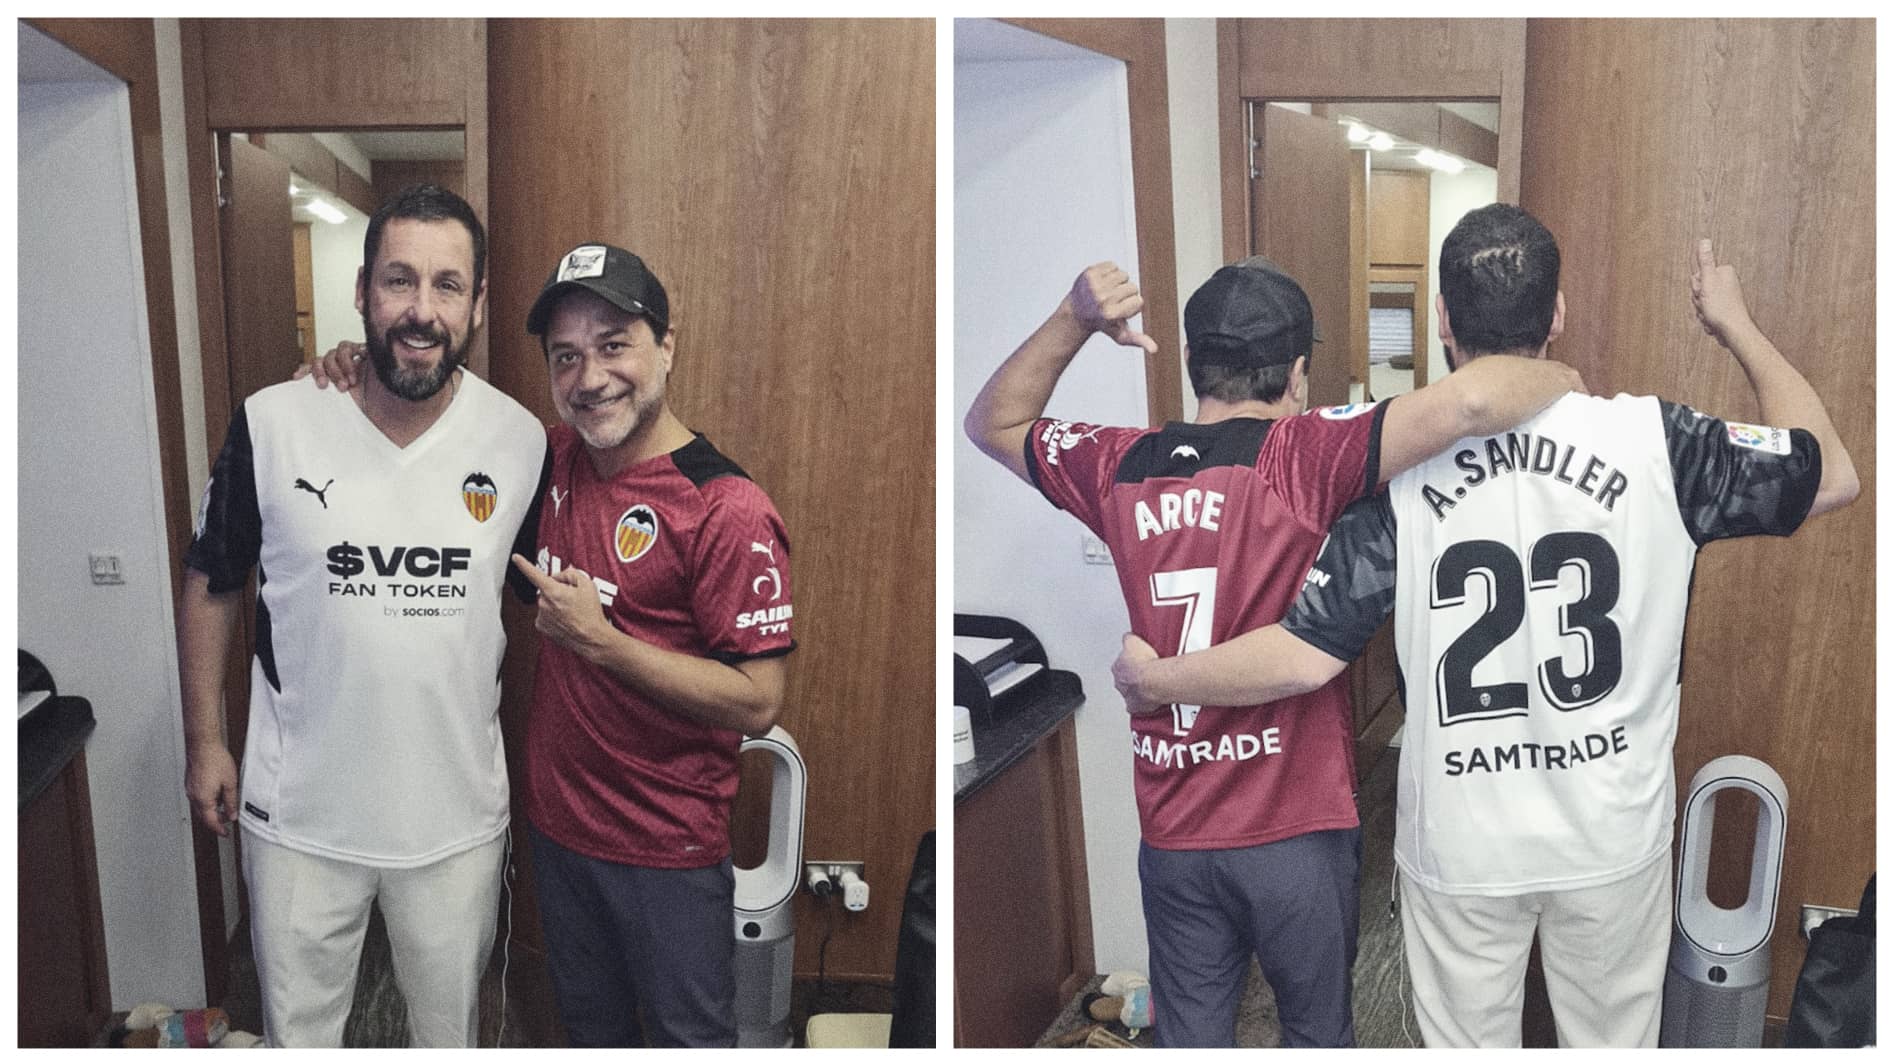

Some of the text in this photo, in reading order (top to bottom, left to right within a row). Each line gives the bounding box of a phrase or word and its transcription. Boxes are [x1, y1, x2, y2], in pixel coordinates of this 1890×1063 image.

[1421, 432, 1628, 523] A.SANDLER
[1135, 488, 1225, 541] ARCE
[326, 541, 471, 580] $VCF
[328, 582, 466, 598] FAN TOKEN
[383, 605, 399, 617] by
[1149, 567, 1218, 736] 7
[1430, 531, 1623, 728] 23
[1445, 726, 1629, 777] SAMTRADE
